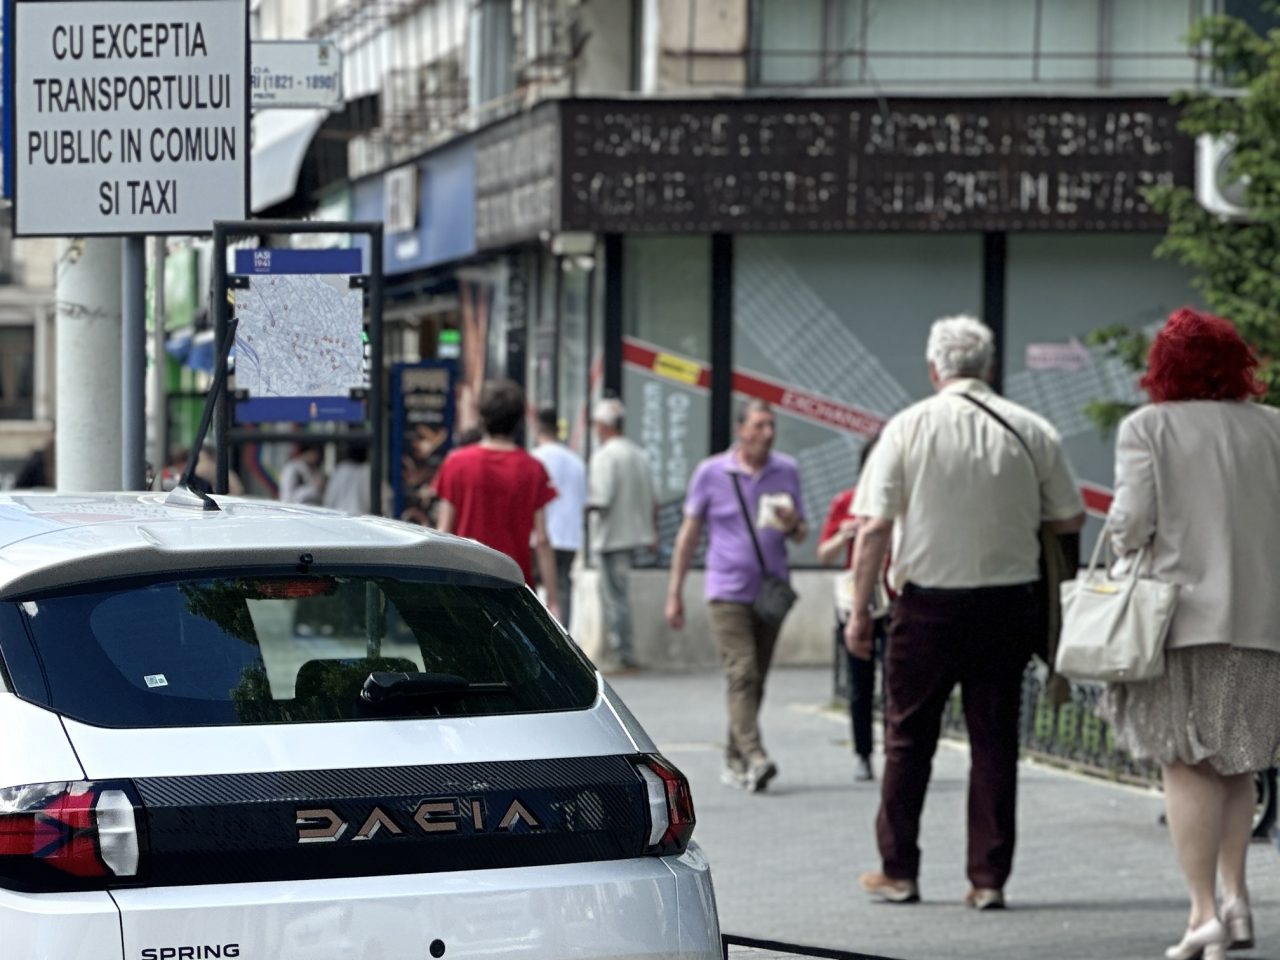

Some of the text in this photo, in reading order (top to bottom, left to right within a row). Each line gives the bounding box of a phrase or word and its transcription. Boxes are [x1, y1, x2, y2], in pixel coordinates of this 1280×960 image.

[52, 22, 208, 60] CU EXCEPTIA
[32, 74, 231, 113] TRANSPORTULUI
[28, 126, 236, 165] PUBLIC IN COMUN
[99, 179, 177, 216] SI TAXI
[295, 799, 547, 844] DACIA
